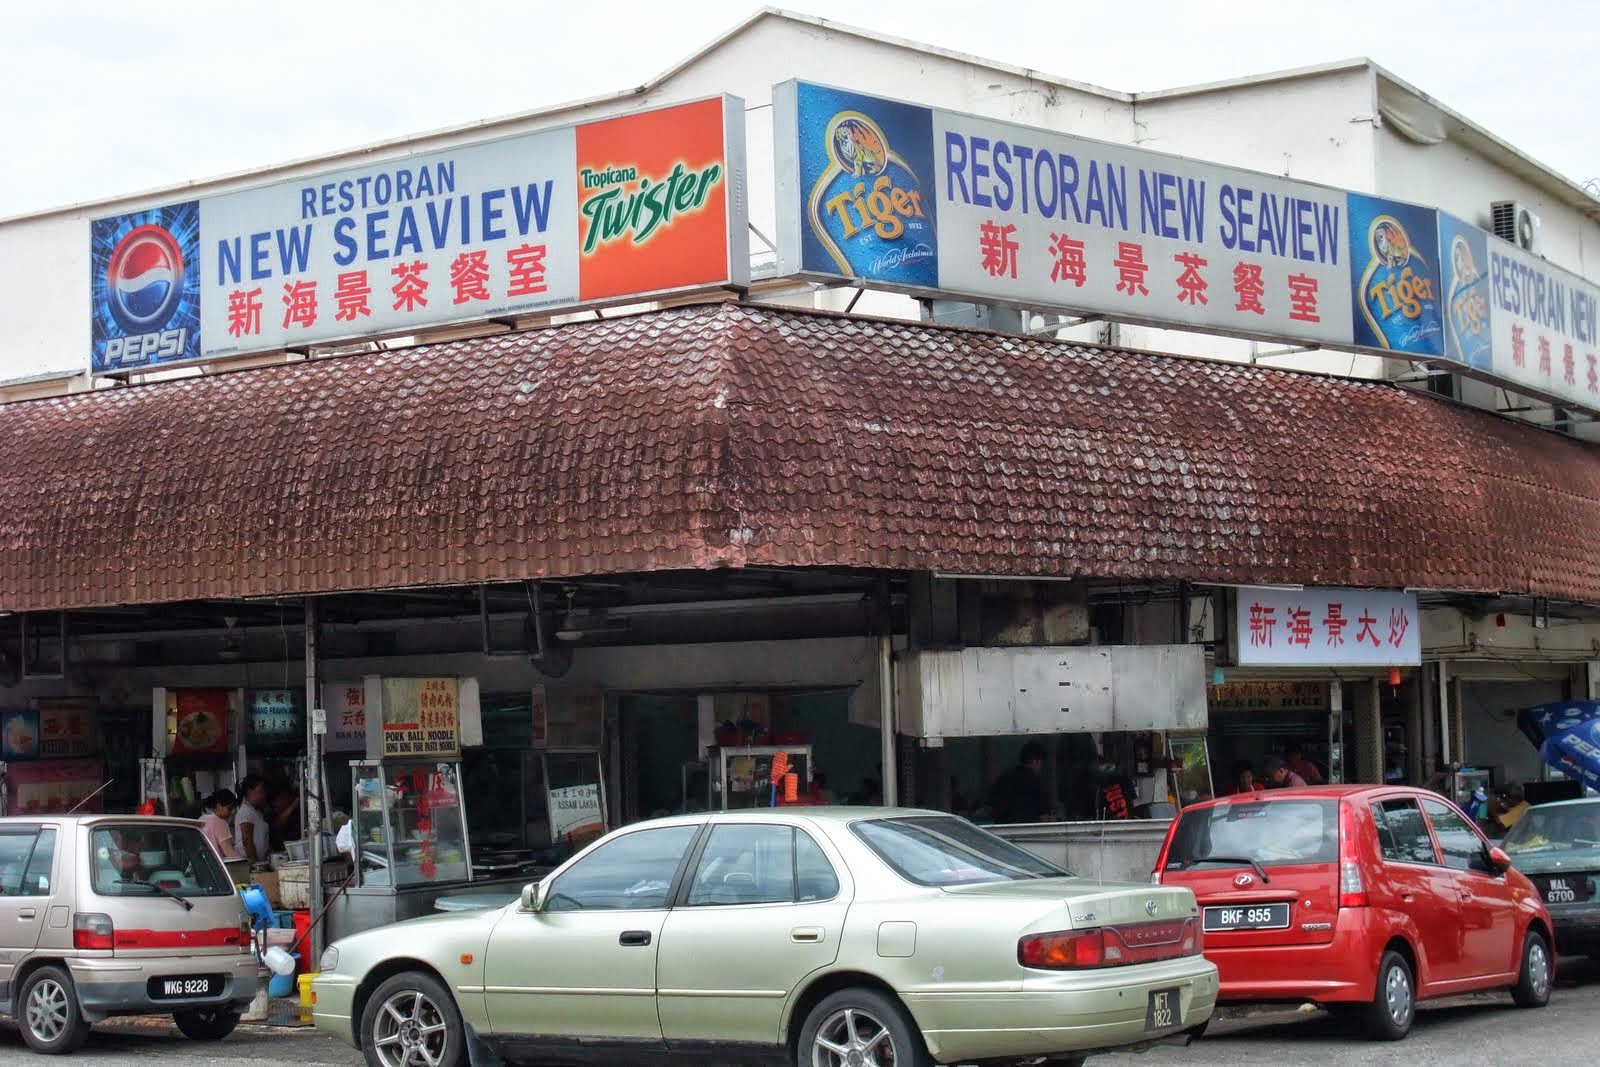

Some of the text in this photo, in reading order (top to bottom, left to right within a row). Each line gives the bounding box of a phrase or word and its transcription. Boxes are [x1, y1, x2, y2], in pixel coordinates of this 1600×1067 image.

[299, 161, 456, 220] RESTORAN
[580, 166, 637, 188] Tropicana
[945, 131, 1339, 264] RESTORAN NEW SEAVIEW
[582, 163, 721, 253] Twister
[825, 175, 924, 240] Tiger
[217, 180, 555, 286] NEW SEAVIEW
[228, 244, 548, 337] 新海景茶餐室
[980, 219, 1321, 324] 新海景茶餐室
[1370, 266, 1434, 320] Tiger
[1490, 251, 1598, 347] RESTORAN NEW
[104, 327, 187, 366] PEPSI
[1250, 602, 1409, 649] 新海景大炒
[385, 730, 454, 742] PORK BALL NOODLE
[557, 799, 598, 810] ASSAM LAKSA
[1548, 890, 1575, 901] 6700
[1550, 879, 1570, 891] WAL
[1136, 929, 1173, 939] CAMRY
[1221, 908, 1271, 924] BKF 955
[164, 979, 209, 995] WKG 9228
[1153, 1008, 1172, 1028] 1822
